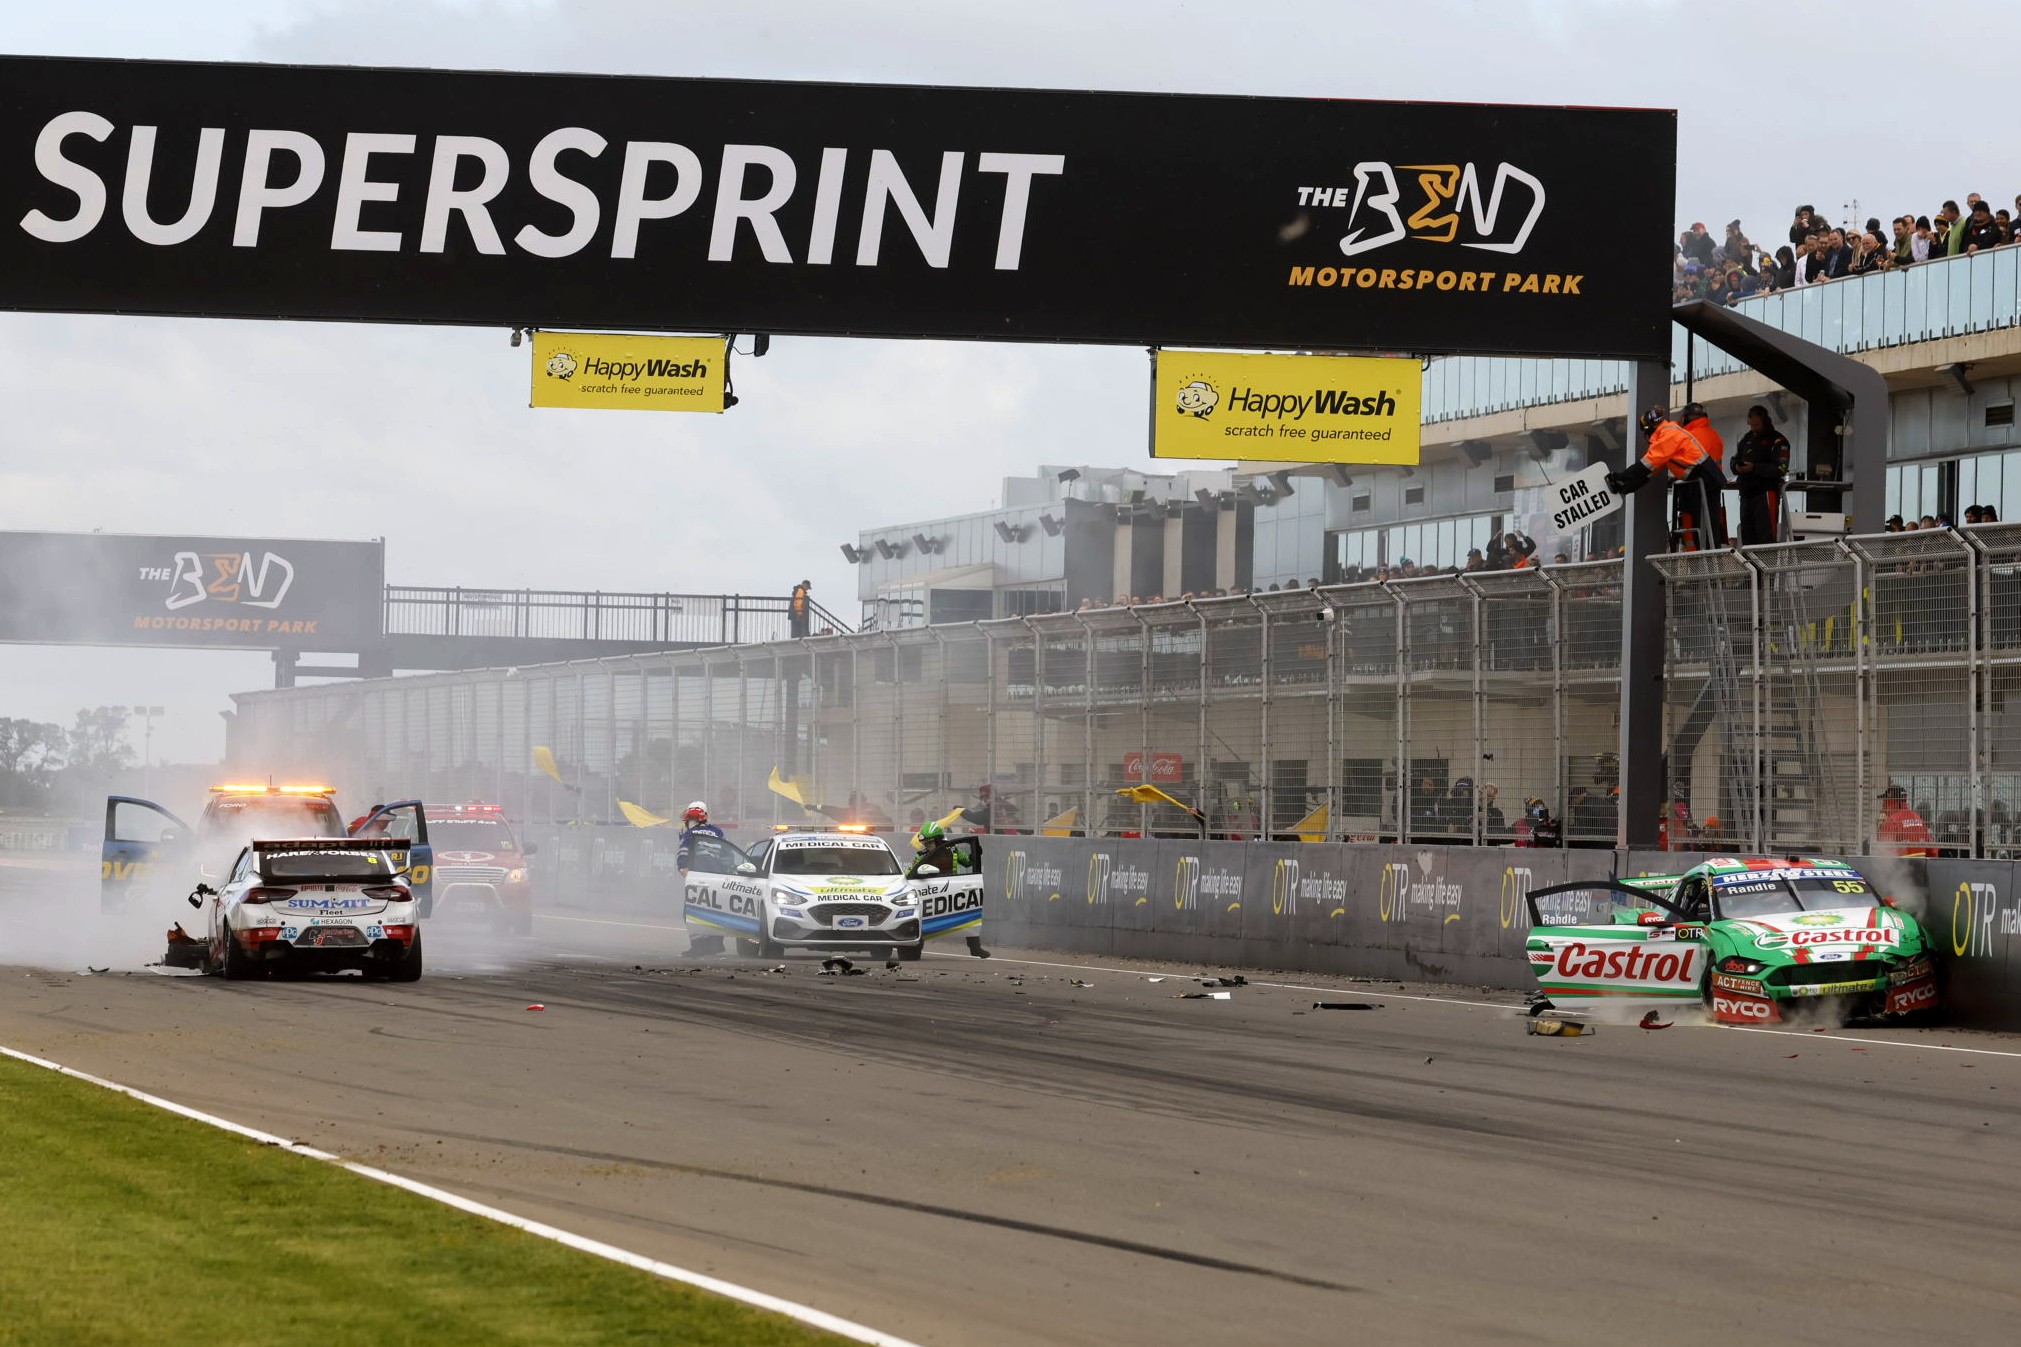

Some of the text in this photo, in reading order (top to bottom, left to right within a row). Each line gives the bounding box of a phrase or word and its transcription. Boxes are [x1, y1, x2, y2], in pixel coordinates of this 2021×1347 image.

[19, 111, 1066, 271] SUPERSPRINT
[1298, 161, 1546, 256] THE BEND
[1288, 266, 1585, 294] MOTORSPORT PARK
[584, 357, 707, 381] HappyWash
[581, 383, 704, 397] scratch free guaranteed
[1228, 387, 1396, 420] HappyWash
[1224, 424, 1392, 441] scratch free guaranteed
[1560, 480, 1589, 504] CAR
[1554, 490, 1611, 529] STALLED
[139, 567, 171, 580] THE
[134, 616, 318, 634] MOTORSPORT PARK
[1005, 851, 1026, 899] OTR
[1088, 853, 1110, 904] OTR
[1175, 856, 1199, 910] OTR
[1201, 867, 1242, 900] making life easy
[1273, 858, 1299, 915] OTR
[721, 880, 762, 896] ultimate
[817, 894, 883, 902] MEDICAL CAR
[1300, 871, 1347, 905] making life easy
[1380, 863, 1408, 922] OTR
[1411, 875, 1463, 912] making life easy
[1500, 866, 1532, 929] OTR
[1727, 882, 1776, 895] Randle
[1833, 881, 1864, 894] 55
[288, 899, 370, 908] SUMMIT
[729, 894, 760, 918] CA
[1542, 914, 1577, 925] Randle
[1952, 882, 1997, 957] OTR
[1678, 928, 1703, 939] OTR
[1791, 928, 1894, 946] Castrol
[1557, 942, 1695, 983] Castrol
[1725, 960, 1744, 971] dba
[1717, 975, 1737, 988] ACT
[1822, 982, 1867, 995] ultimate
[1713, 997, 1770, 1018] RYCO
[1894, 984, 1936, 1010] RYCO
